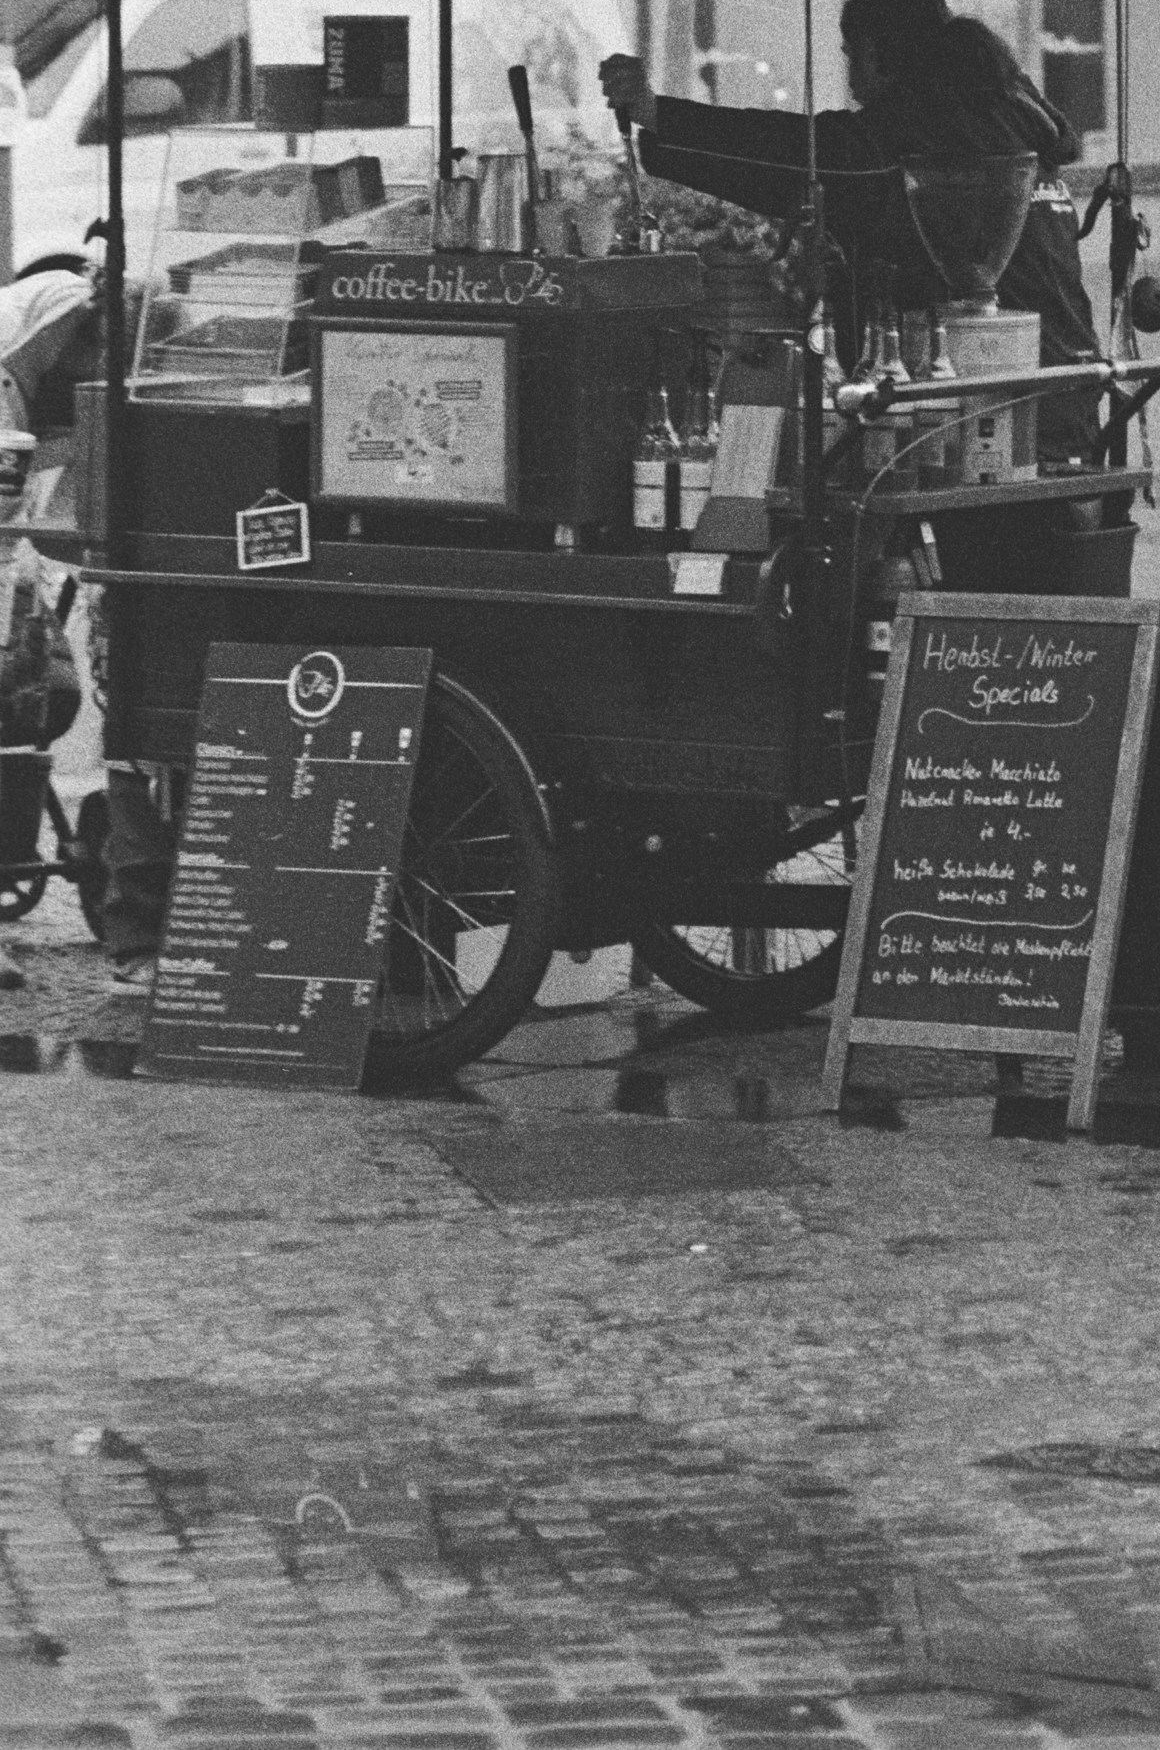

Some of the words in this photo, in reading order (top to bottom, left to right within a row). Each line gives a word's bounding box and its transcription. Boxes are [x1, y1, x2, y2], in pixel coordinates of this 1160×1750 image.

[968, 675, 1059, 715] Specials
[990, 758, 1061, 782] Macchiato
[1025, 790, 1063, 809] Latte
[939, 859, 1015, 881] Schokolade
[877, 933, 923, 958] Bitte
[931, 933, 985, 954] beachtet
[872, 969, 892, 985] an
